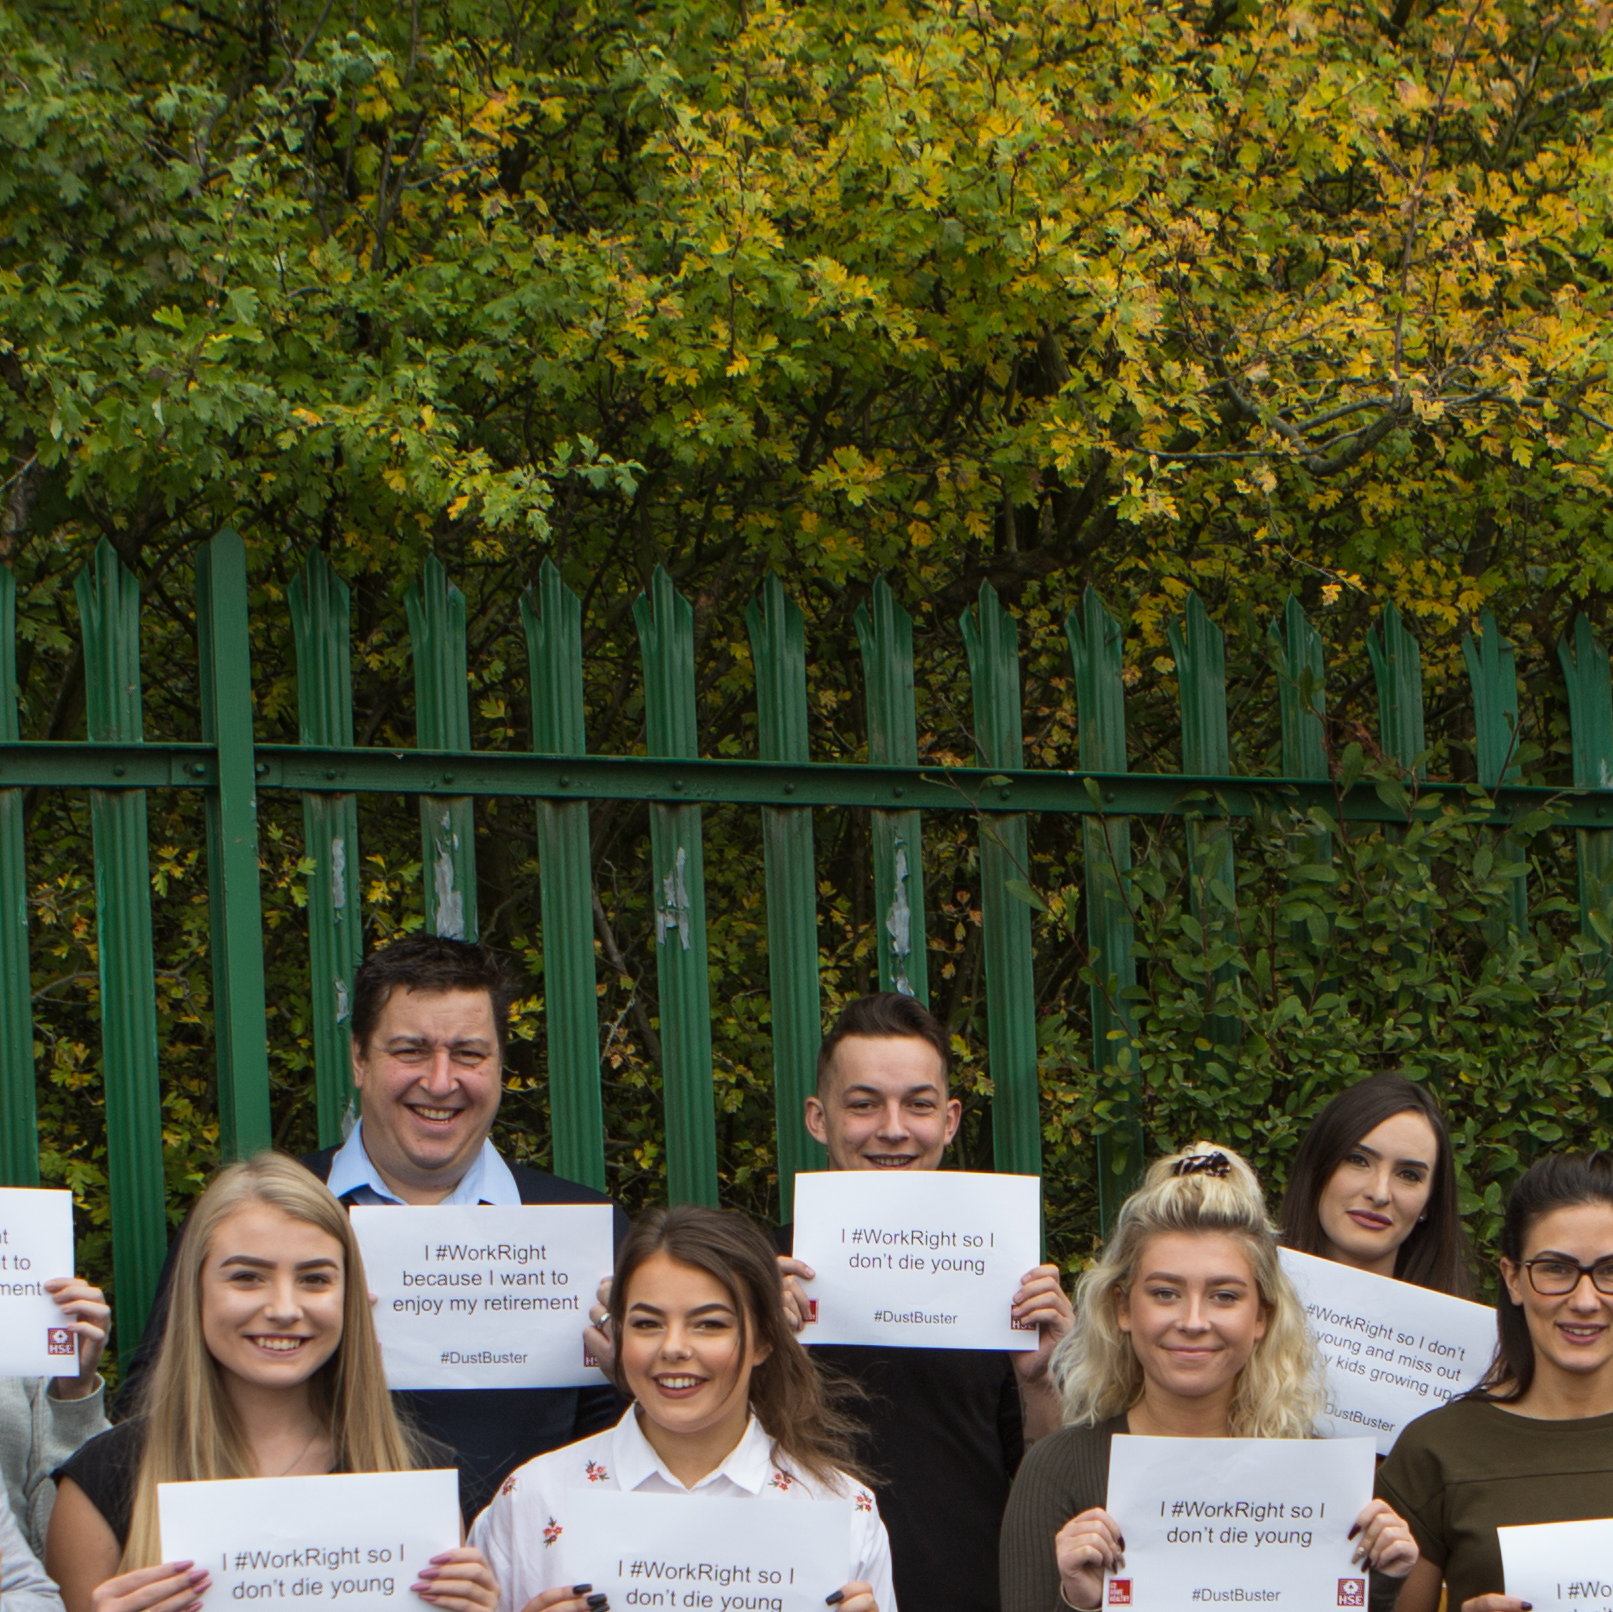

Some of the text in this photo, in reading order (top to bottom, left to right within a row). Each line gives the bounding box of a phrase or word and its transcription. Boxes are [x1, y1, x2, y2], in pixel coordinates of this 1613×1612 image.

[852, 1228, 984, 1250] #WorkRight so
[13, 1255, 31, 1271] to
[435, 1244, 546, 1265] #WorkRight
[898, 1254, 925, 1270] die
[931, 1259, 985, 1276] young
[403, 1270, 482, 1287] because
[500, 1270, 545, 1286] want
[551, 1270, 568, 1285] to
[393, 1295, 579, 1316] enjoy my retirement
[874, 1310, 958, 1324] #DustBuster
[1307, 1303, 1394, 1340] #WorkRight
[1396, 1332, 1415, 1346] so
[49, 1344, 74, 1354] HSE
[440, 1351, 528, 1364] #DustBuster
[1317, 1331, 1461, 1382] young and miss out
[1336, 1355, 1452, 1402] kids growing up
[1324, 1402, 1396, 1432] DustBuster
[1171, 1501, 1313, 1522] #WorkRight so
[1220, 1527, 1248, 1543] die
[1254, 1531, 1312, 1548] young
[235, 1547, 392, 1571] #WorkRight so
[630, 1561, 782, 1587] #WorkRight so
[291, 1578, 323, 1596] die
[331, 1577, 394, 1599] young
[1192, 1588, 1281, 1602] #DustBuster
[683, 1590, 713, 1608] die
[1338, 1595, 1364, 1605] HSE
